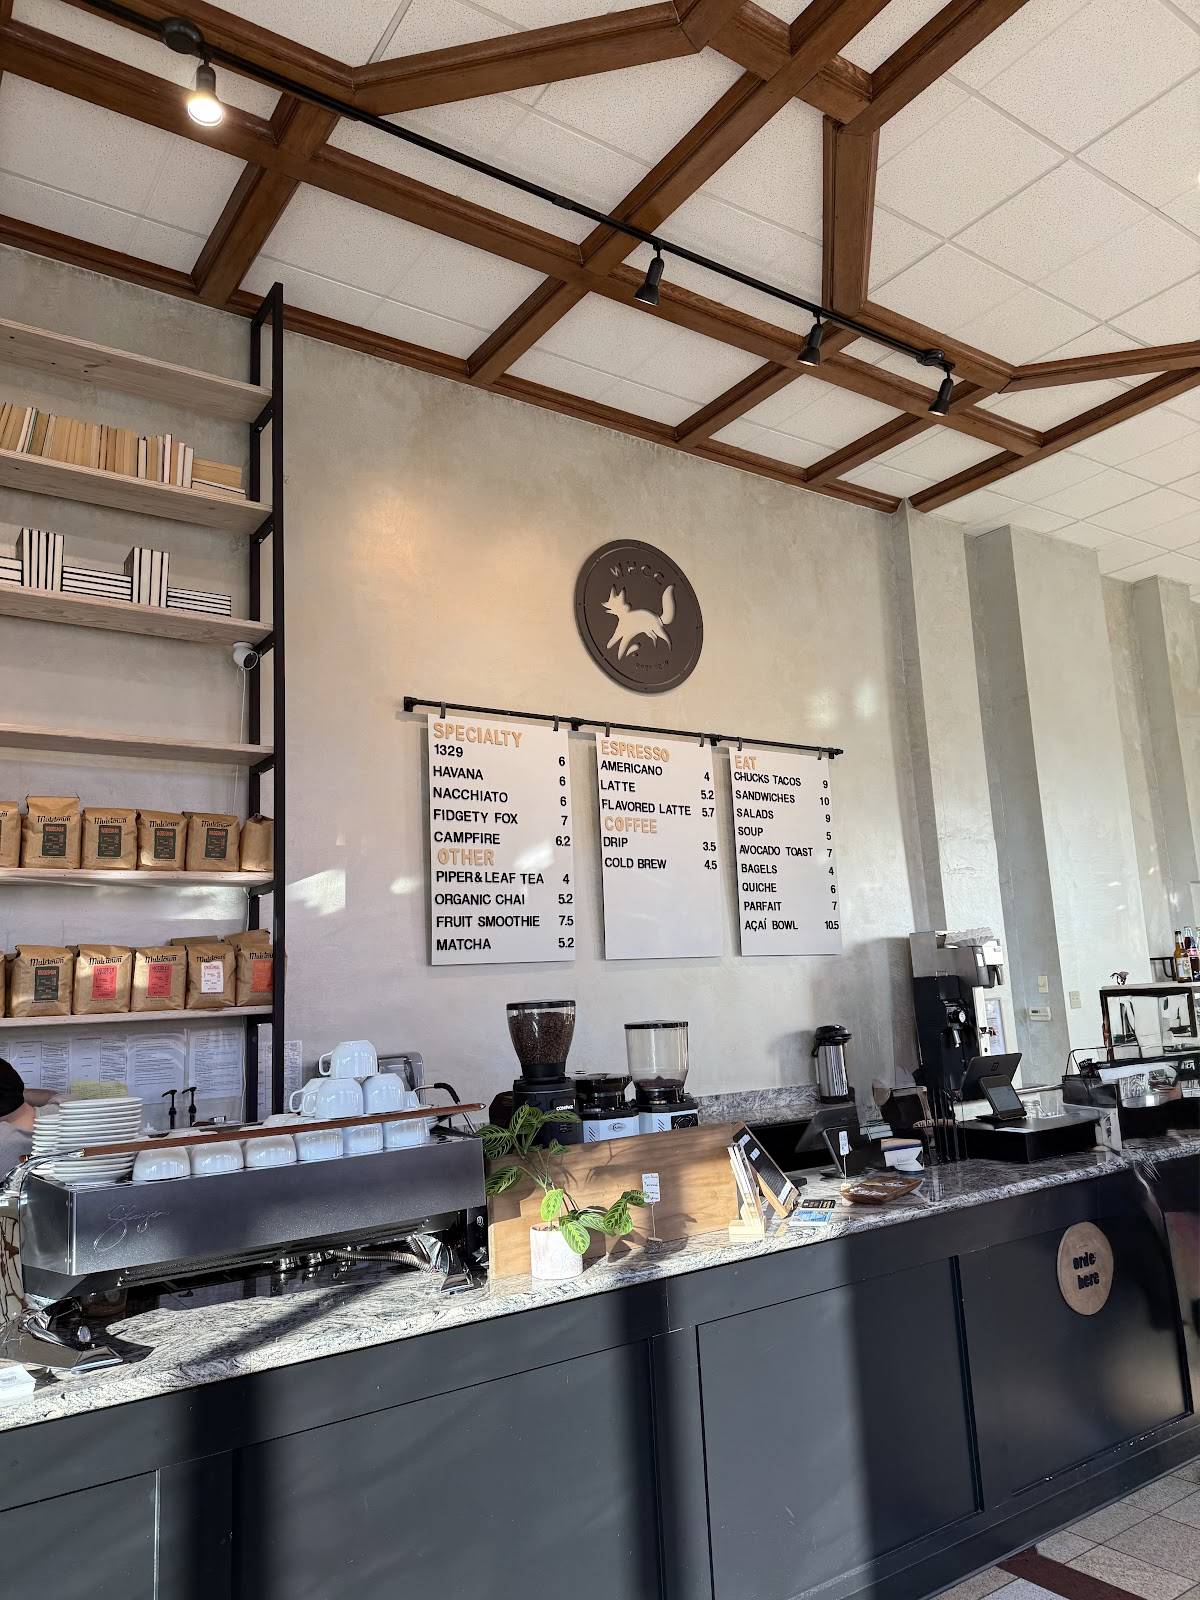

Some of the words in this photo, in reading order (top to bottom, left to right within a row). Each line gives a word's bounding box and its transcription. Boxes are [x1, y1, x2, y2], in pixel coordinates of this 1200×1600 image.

[433, 722, 523, 748] SPECIALTY
[434, 744, 464, 758] 1329
[558, 756, 566, 767] 6
[600, 739, 670, 762] ESPRESSO
[734, 754, 757, 770] EAT
[433, 766, 484, 780] HAVANA
[559, 776, 566, 786] 6
[600, 760, 663, 776] AMERICANO
[704, 772, 710, 781] 4
[734, 771, 770, 784] CHUCKS
[772, 775, 802, 787] TACOS
[822, 780, 828, 789] 9
[433, 786, 508, 803] NACCHIATO
[560, 796, 567, 806] 6
[600, 779, 636, 792] LATTE
[700, 790, 715, 800] 5.2
[735, 789, 796, 804] SANDWICHES
[820, 797, 830, 806] 10
[601, 799, 656, 813] FLAVORED
[659, 803, 692, 816] LATTE
[701, 807, 715, 818] 5.7
[736, 808, 774, 819] SALADS
[825, 814, 831, 823] 9
[433, 808, 489, 823] FIDGETY
[494, 812, 518, 824] FOX
[561, 815, 568, 826] 7
[604, 815, 657, 834] COFFEE
[433, 831, 501, 845] CAMPFIRE
[555, 836, 571, 847] 6.2
[737, 826, 764, 836] SOUP
[826, 831, 832, 841] 5
[603, 836, 628, 848] DRIP
[702, 841, 717, 852] 3.5
[739, 844, 781, 856] AVOCADO
[785, 846, 813, 857] TOAST
[826, 848, 833, 858] 7
[437, 847, 495, 866] OTHER
[604, 857, 634, 868] COLD
[637, 859, 667, 869] BREW
[704, 860, 718, 870] 4.5
[741, 863, 778, 874] BAGELS
[828, 866, 834, 875] 4
[520, 873, 544, 884] TEA
[562, 874, 570, 884] 4
[742, 882, 777, 893] QUICHE
[830, 885, 836, 894] 6
[434, 893, 492, 906] ORGANIC
[495, 894, 525, 905] CHAI
[558, 894, 573, 904] 5.2
[744, 901, 782, 911] PARFAIT
[831, 901, 837, 911] 7
[436, 915, 473, 928] FRUIT
[478, 915, 540, 927] SMOOTHIE
[558, 915, 574, 926] 7.5
[745, 917, 767, 932] AÇAÍ
[772, 920, 799, 930] BOWL
[824, 920, 840, 930] 10.5
[436, 938, 492, 951] MATCHA
[558, 937, 575, 948] 5.2
[1077, 1272, 1100, 1290] here
